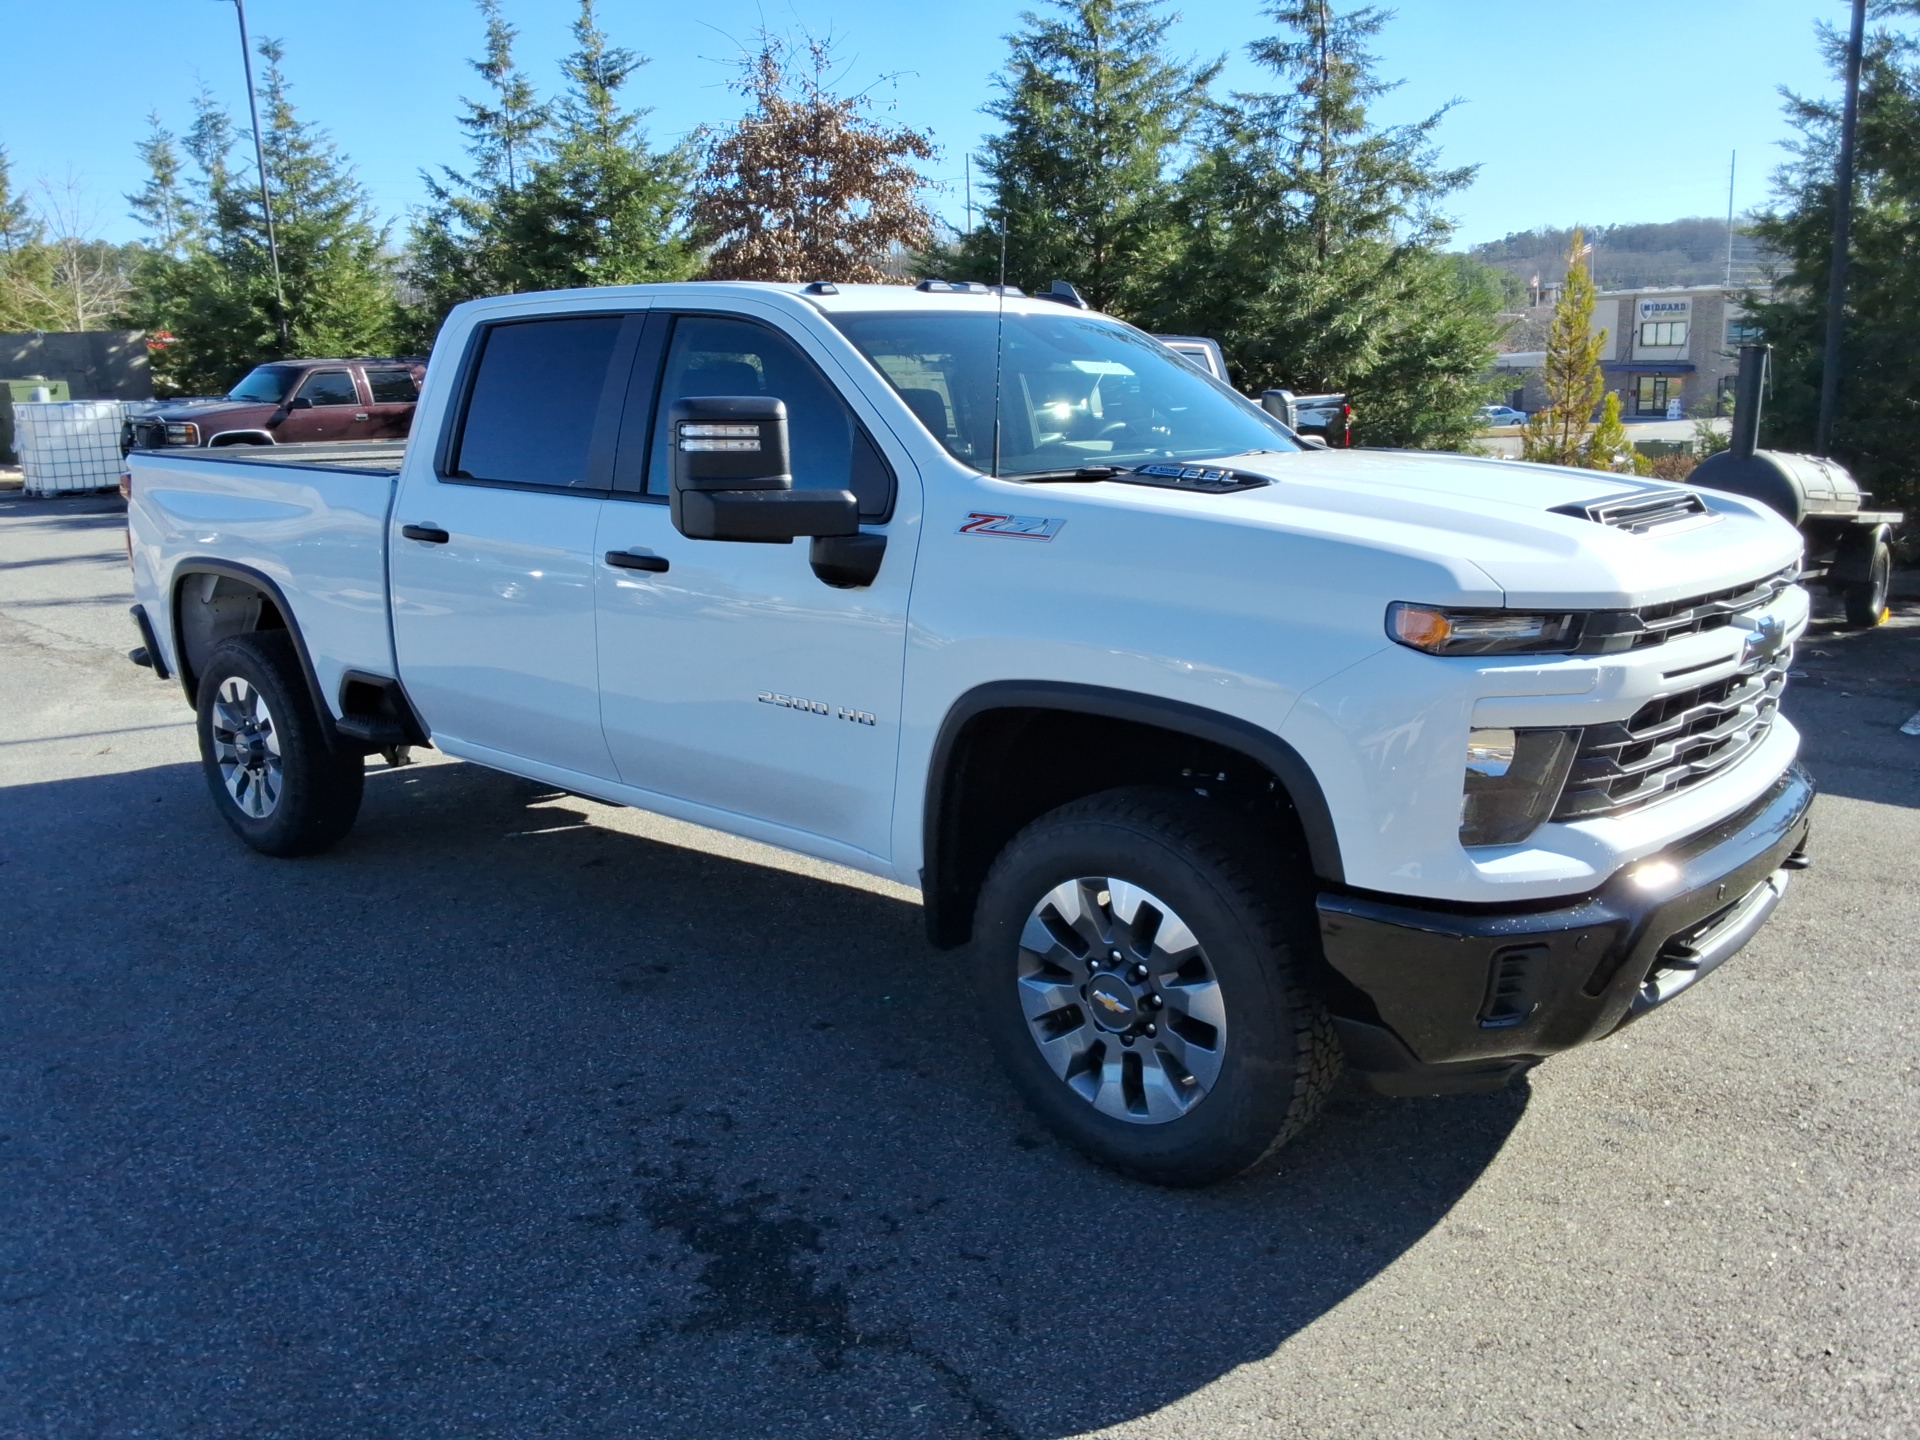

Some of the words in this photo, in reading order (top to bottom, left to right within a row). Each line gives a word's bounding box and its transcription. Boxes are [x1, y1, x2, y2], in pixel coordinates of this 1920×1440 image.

[1643, 303, 1686, 311] MIDGARD
[956, 511, 1065, 542] Z71
[757, 689, 829, 716] 2500
[837, 705, 877, 727] HD
